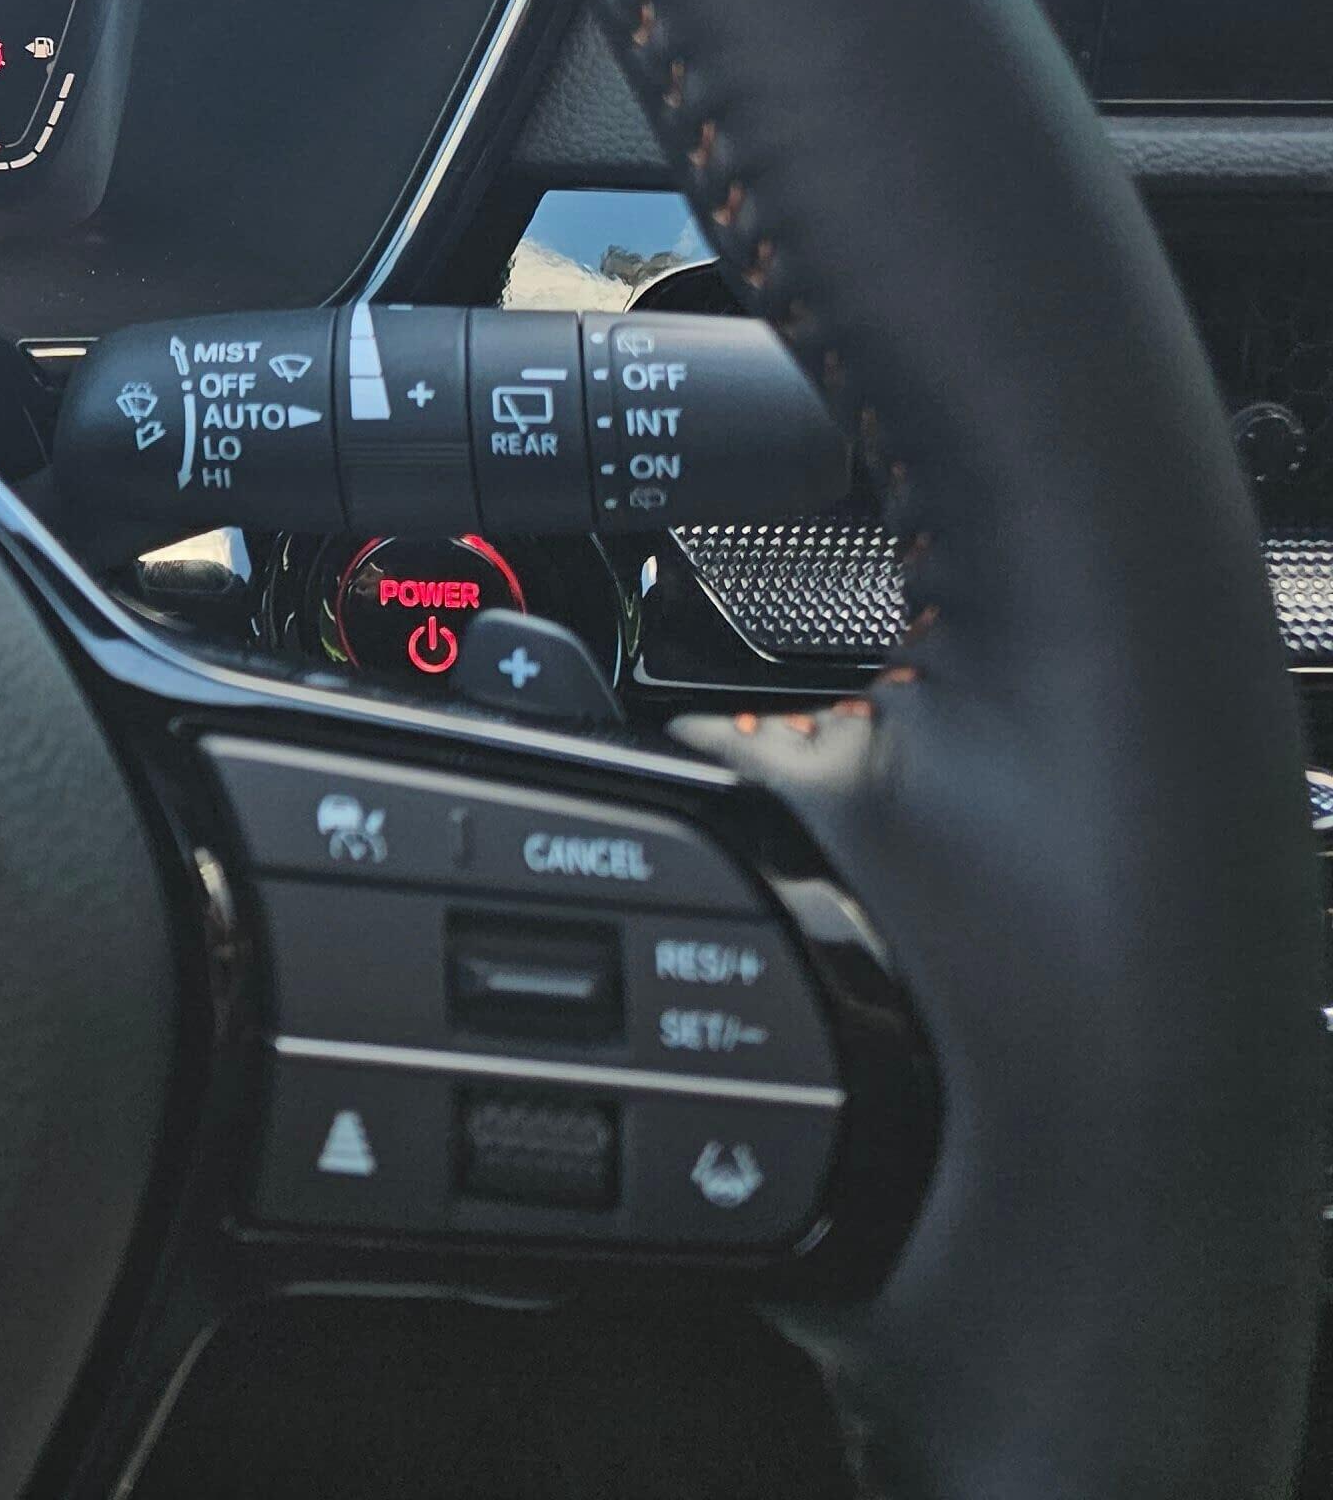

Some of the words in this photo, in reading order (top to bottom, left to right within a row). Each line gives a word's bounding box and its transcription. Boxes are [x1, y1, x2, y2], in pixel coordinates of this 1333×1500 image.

[193, 340, 262, 364] MIST
[199, 371, 257, 399] OFF
[621, 363, 687, 391] OFF
[202, 403, 286, 431] AUTO
[626, 407, 682, 437] INT
[202, 435, 242, 461] LO
[490, 432, 558, 457] REAR
[202, 467, 232, 489] HI
[629, 453, 681, 480] ON
[379, 579, 480, 609] POWER
[523, 833, 654, 881] CANCEL
